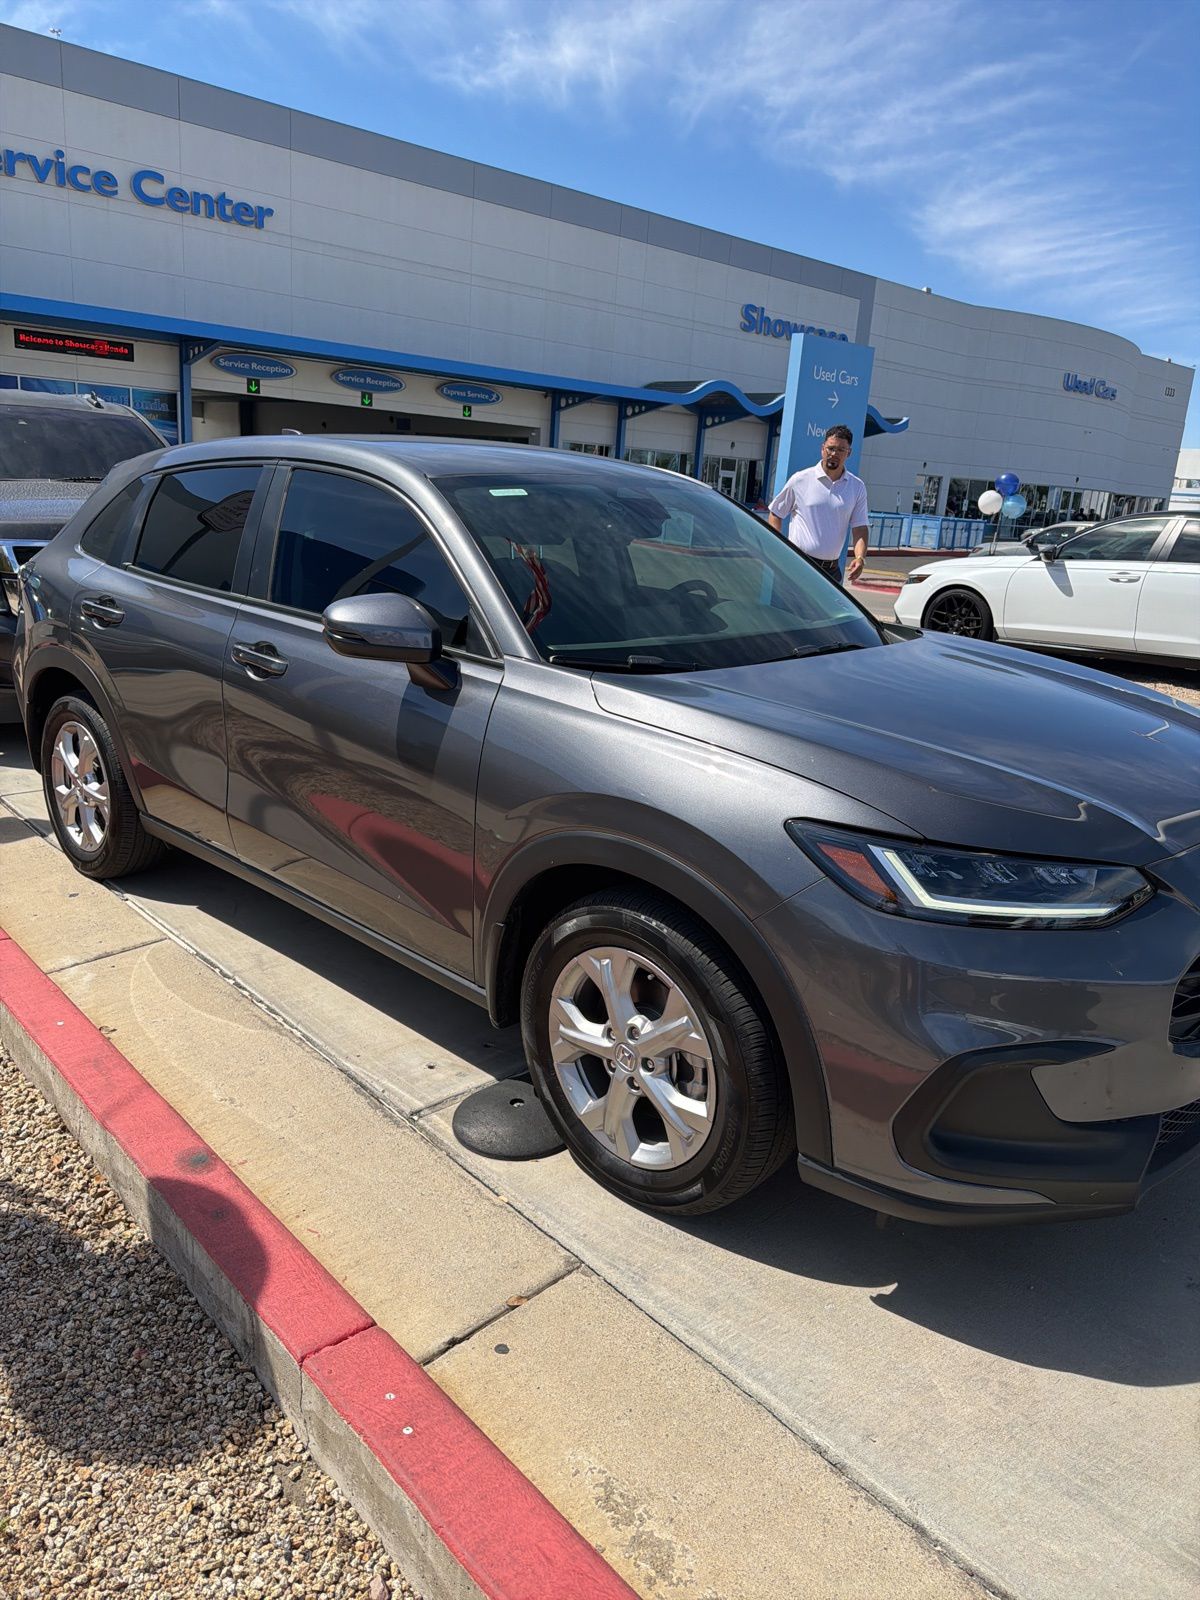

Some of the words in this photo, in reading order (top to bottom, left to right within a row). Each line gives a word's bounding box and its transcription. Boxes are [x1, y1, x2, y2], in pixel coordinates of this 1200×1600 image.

[0, 149, 119, 197] rvice
[130, 169, 274, 229] Center
[19, 333, 54, 345] Welcome
[219, 358, 250, 369] Service
[251, 362, 291, 374] Reception
[338, 373, 365, 383] Service
[366, 376, 401, 388] Reception
[814, 365, 837, 382] Used
[838, 370, 859, 386] Cars
[443, 387, 467, 396] Express
[467, 390, 489, 400] Service
[1063, 372, 1096, 395] Used
[1094, 380, 1117, 401] Cars
